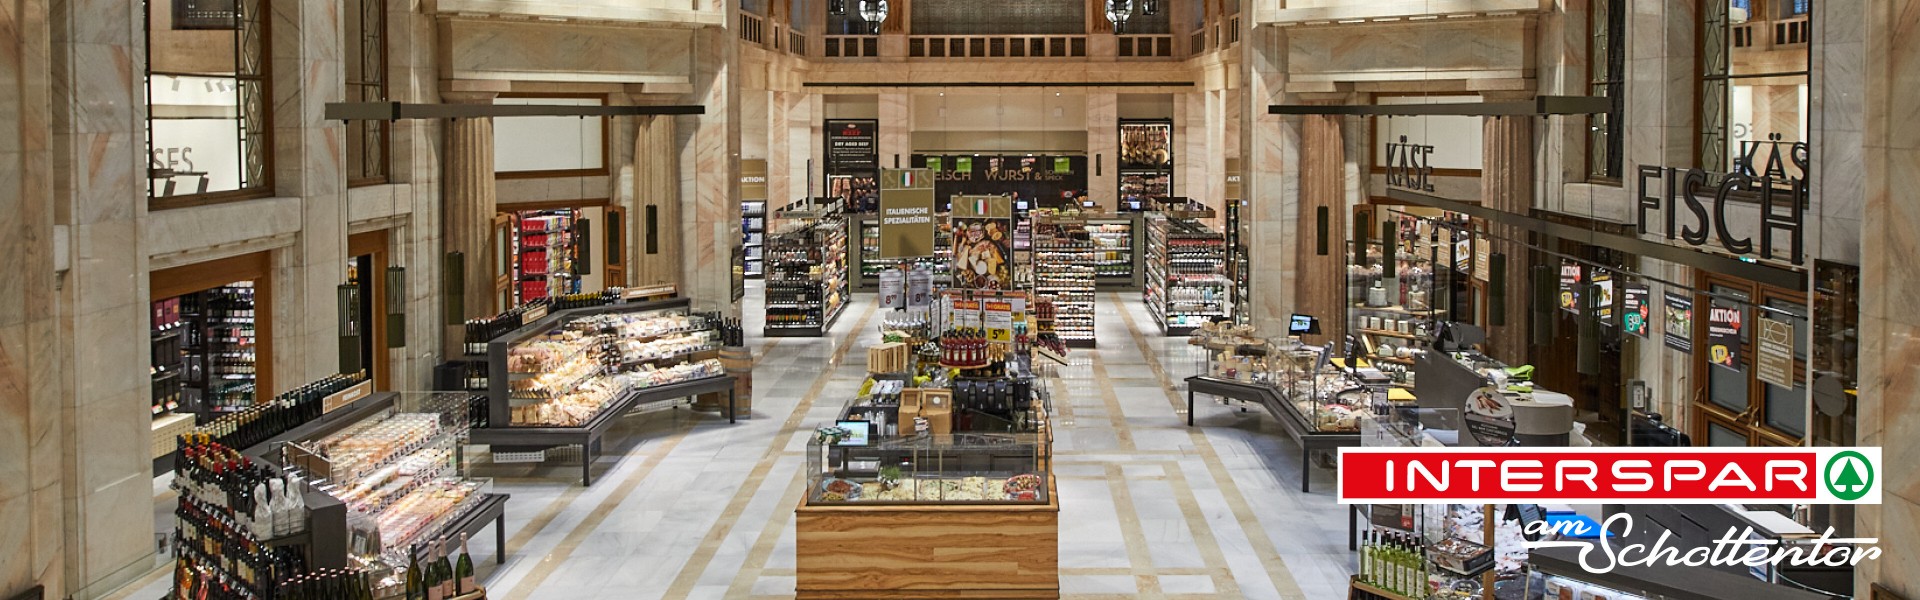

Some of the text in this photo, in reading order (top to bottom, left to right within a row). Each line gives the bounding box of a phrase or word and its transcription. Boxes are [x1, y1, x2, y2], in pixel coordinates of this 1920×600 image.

[1386, 135, 1434, 192] KÄSE
[1740, 133, 1808, 181] KÄS
[934, 169, 971, 180] EISCH
[985, 169, 1030, 180] WURST
[1034, 172, 1042, 180] &
[886, 207, 928, 215] ITALIENISCHE
[1638, 165, 1804, 265] FISCH
[884, 215, 930, 224] SPEZIALITÄTEN
[1710, 308, 1740, 323] AKTION
